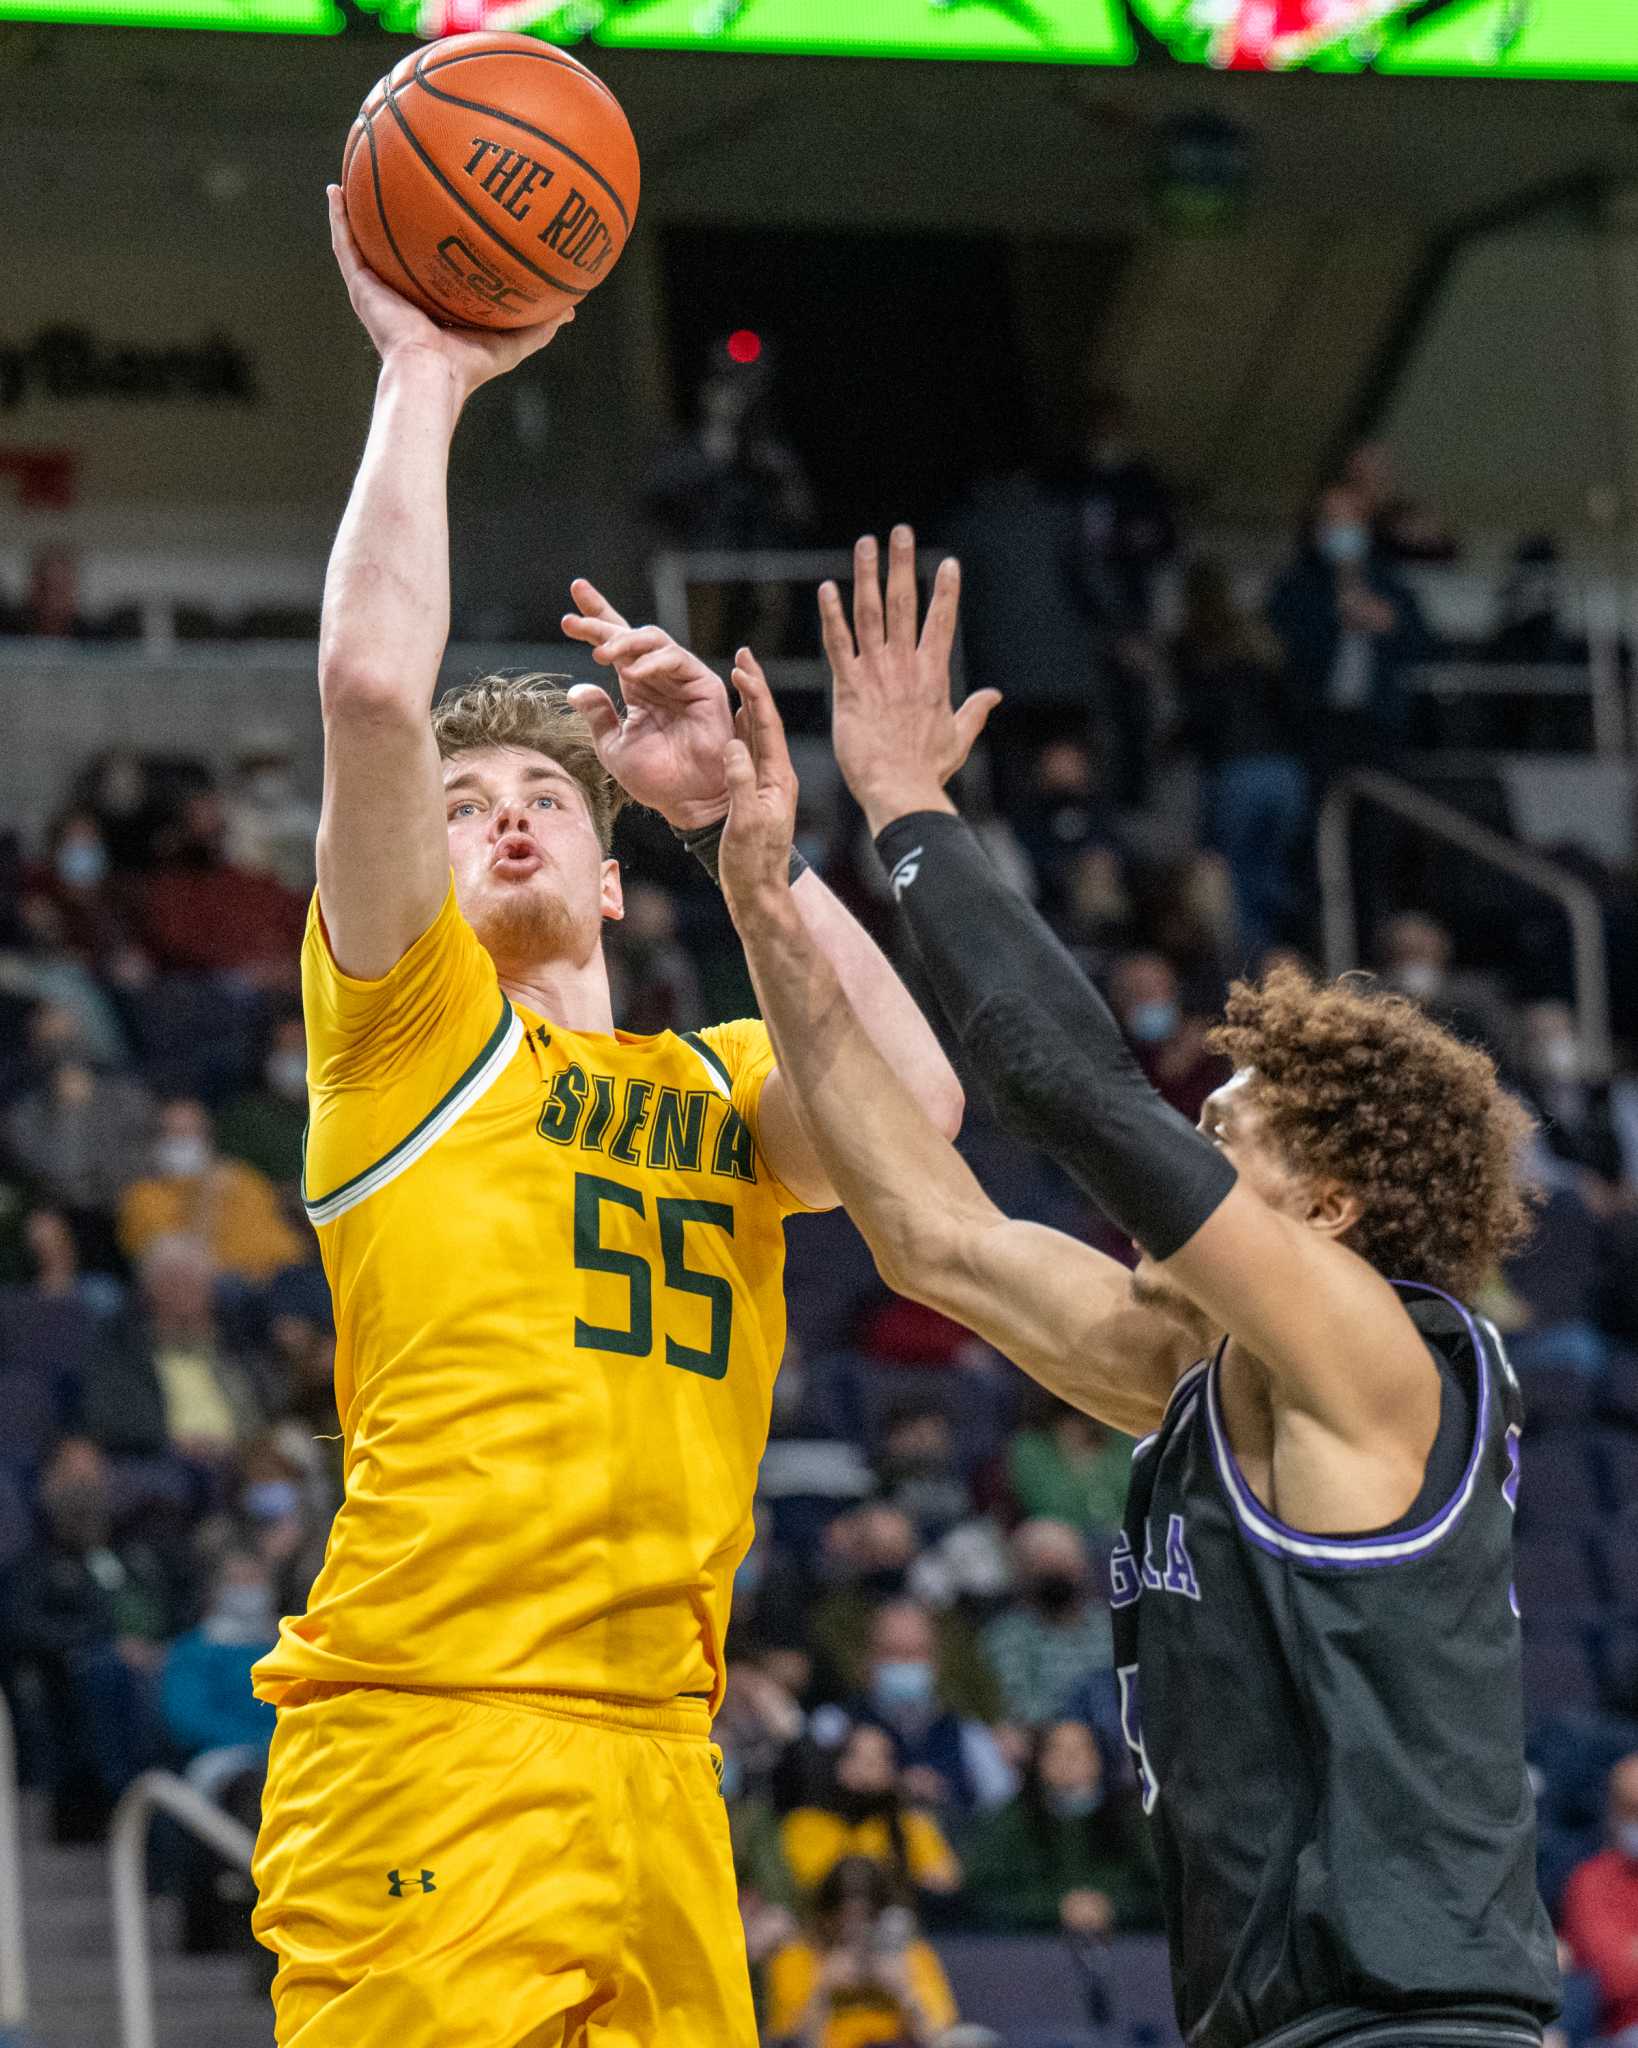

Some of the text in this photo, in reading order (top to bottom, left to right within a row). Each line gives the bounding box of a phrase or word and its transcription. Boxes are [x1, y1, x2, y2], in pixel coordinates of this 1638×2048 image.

[463, 137, 555, 222] THE
[536, 1062, 757, 1184] SIENA
[574, 1171, 734, 1381] 55
